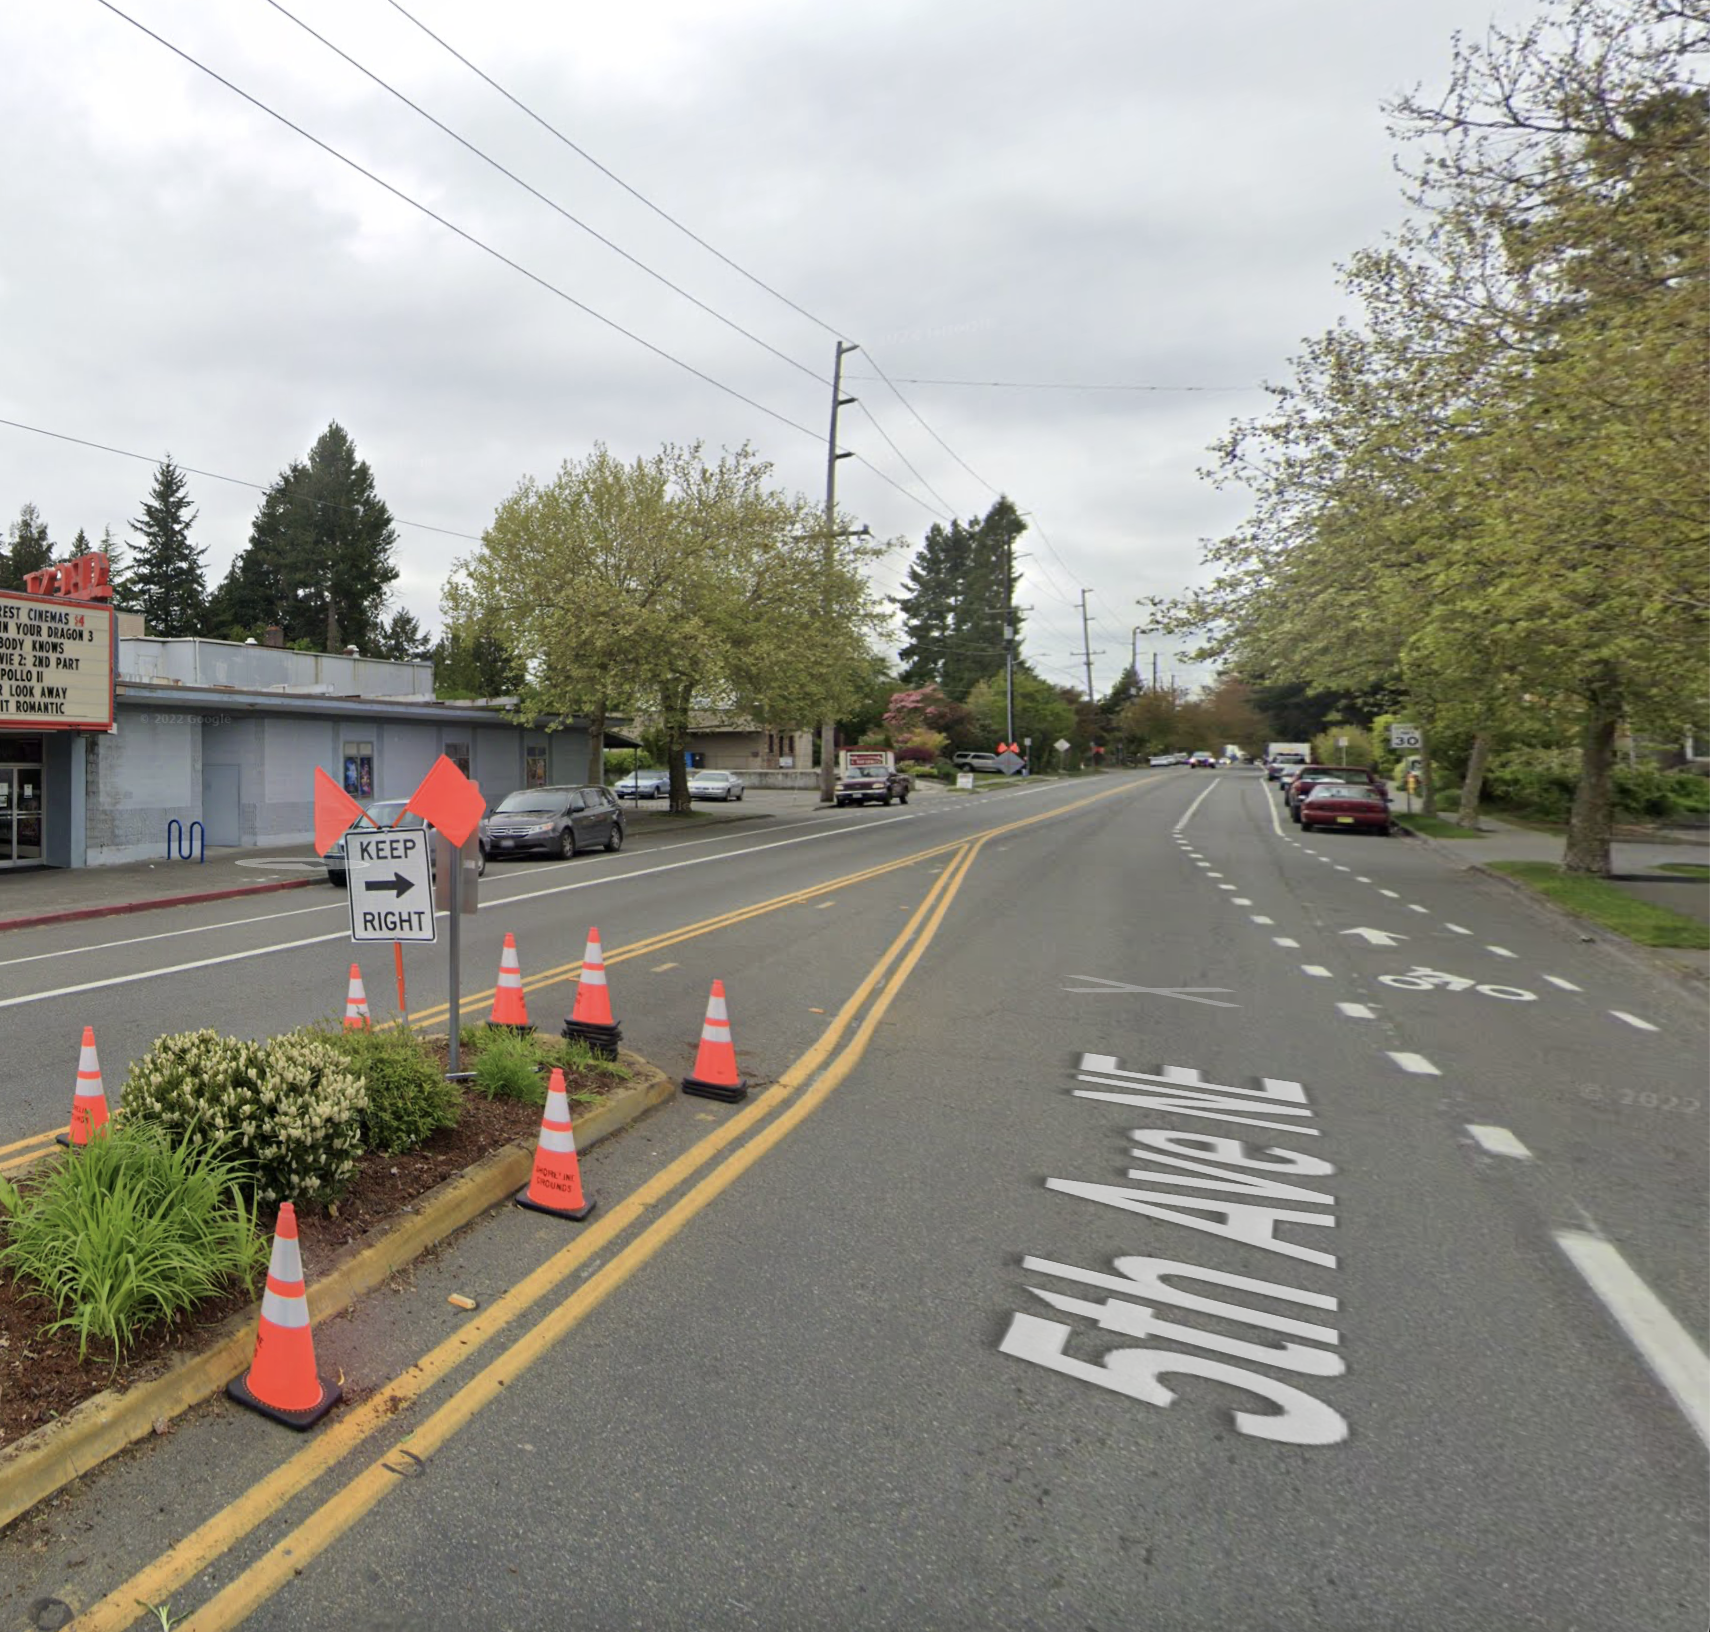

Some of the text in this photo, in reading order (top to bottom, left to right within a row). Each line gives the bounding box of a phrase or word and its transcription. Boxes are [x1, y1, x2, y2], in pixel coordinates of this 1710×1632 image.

[28, 608, 70, 625] CINEMAS
[74, 614, 85, 627] $4
[16, 622, 42, 637] YOUR
[47, 626, 84, 641] DRAGON
[87, 630, 94, 642] 3
[32, 640, 65, 654] KNOWS
[18, 653, 27, 666] 2:
[32, 655, 50, 668] 2ND
[56, 657, 80, 671] PART
[10, 684, 35, 698] LOOK
[40, 686, 67, 700] AWAY
[0, 699, 10, 712] IT
[16, 700, 65, 714] ROMANTIC
[1394, 736, 1419, 746] 30
[359, 838, 417, 861] KEEP
[363, 911, 426, 933] RIGHT
